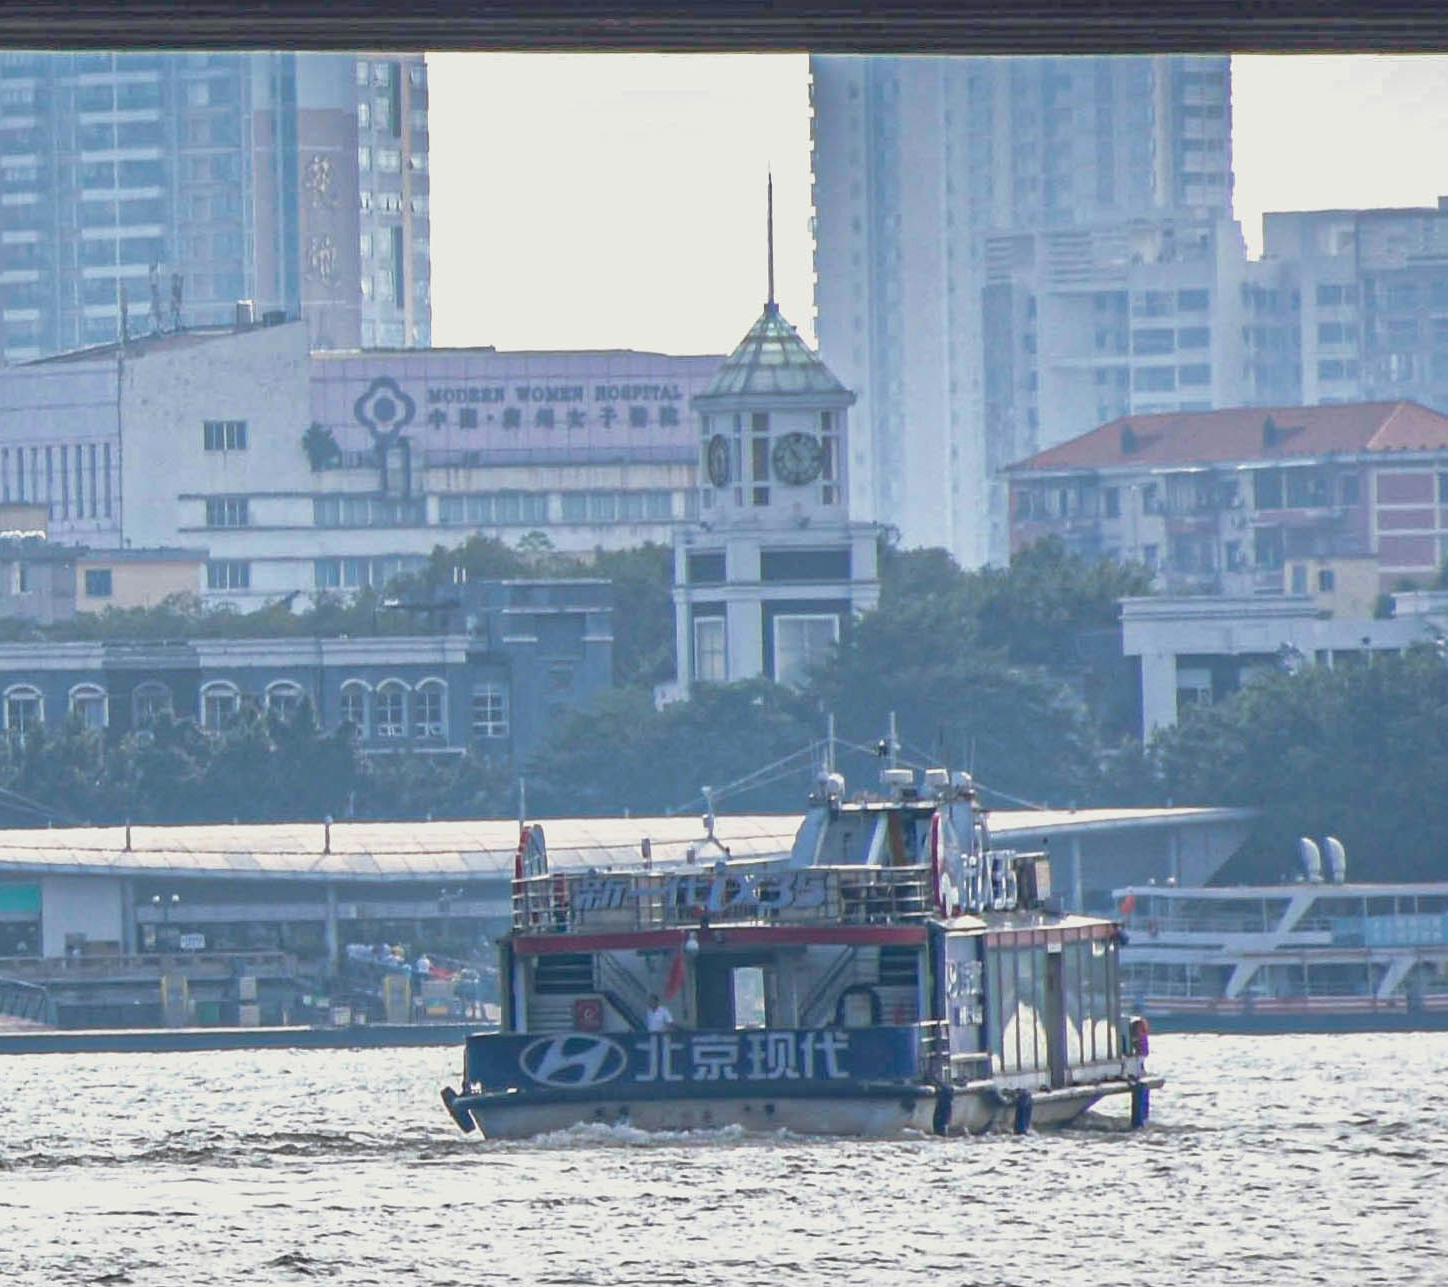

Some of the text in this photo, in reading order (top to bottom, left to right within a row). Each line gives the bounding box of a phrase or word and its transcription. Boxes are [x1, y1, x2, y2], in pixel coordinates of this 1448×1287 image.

[428, 384, 683, 404] MODERN WOMEN HOSPITAL
[635, 1031, 850, 1082] 北京现代
